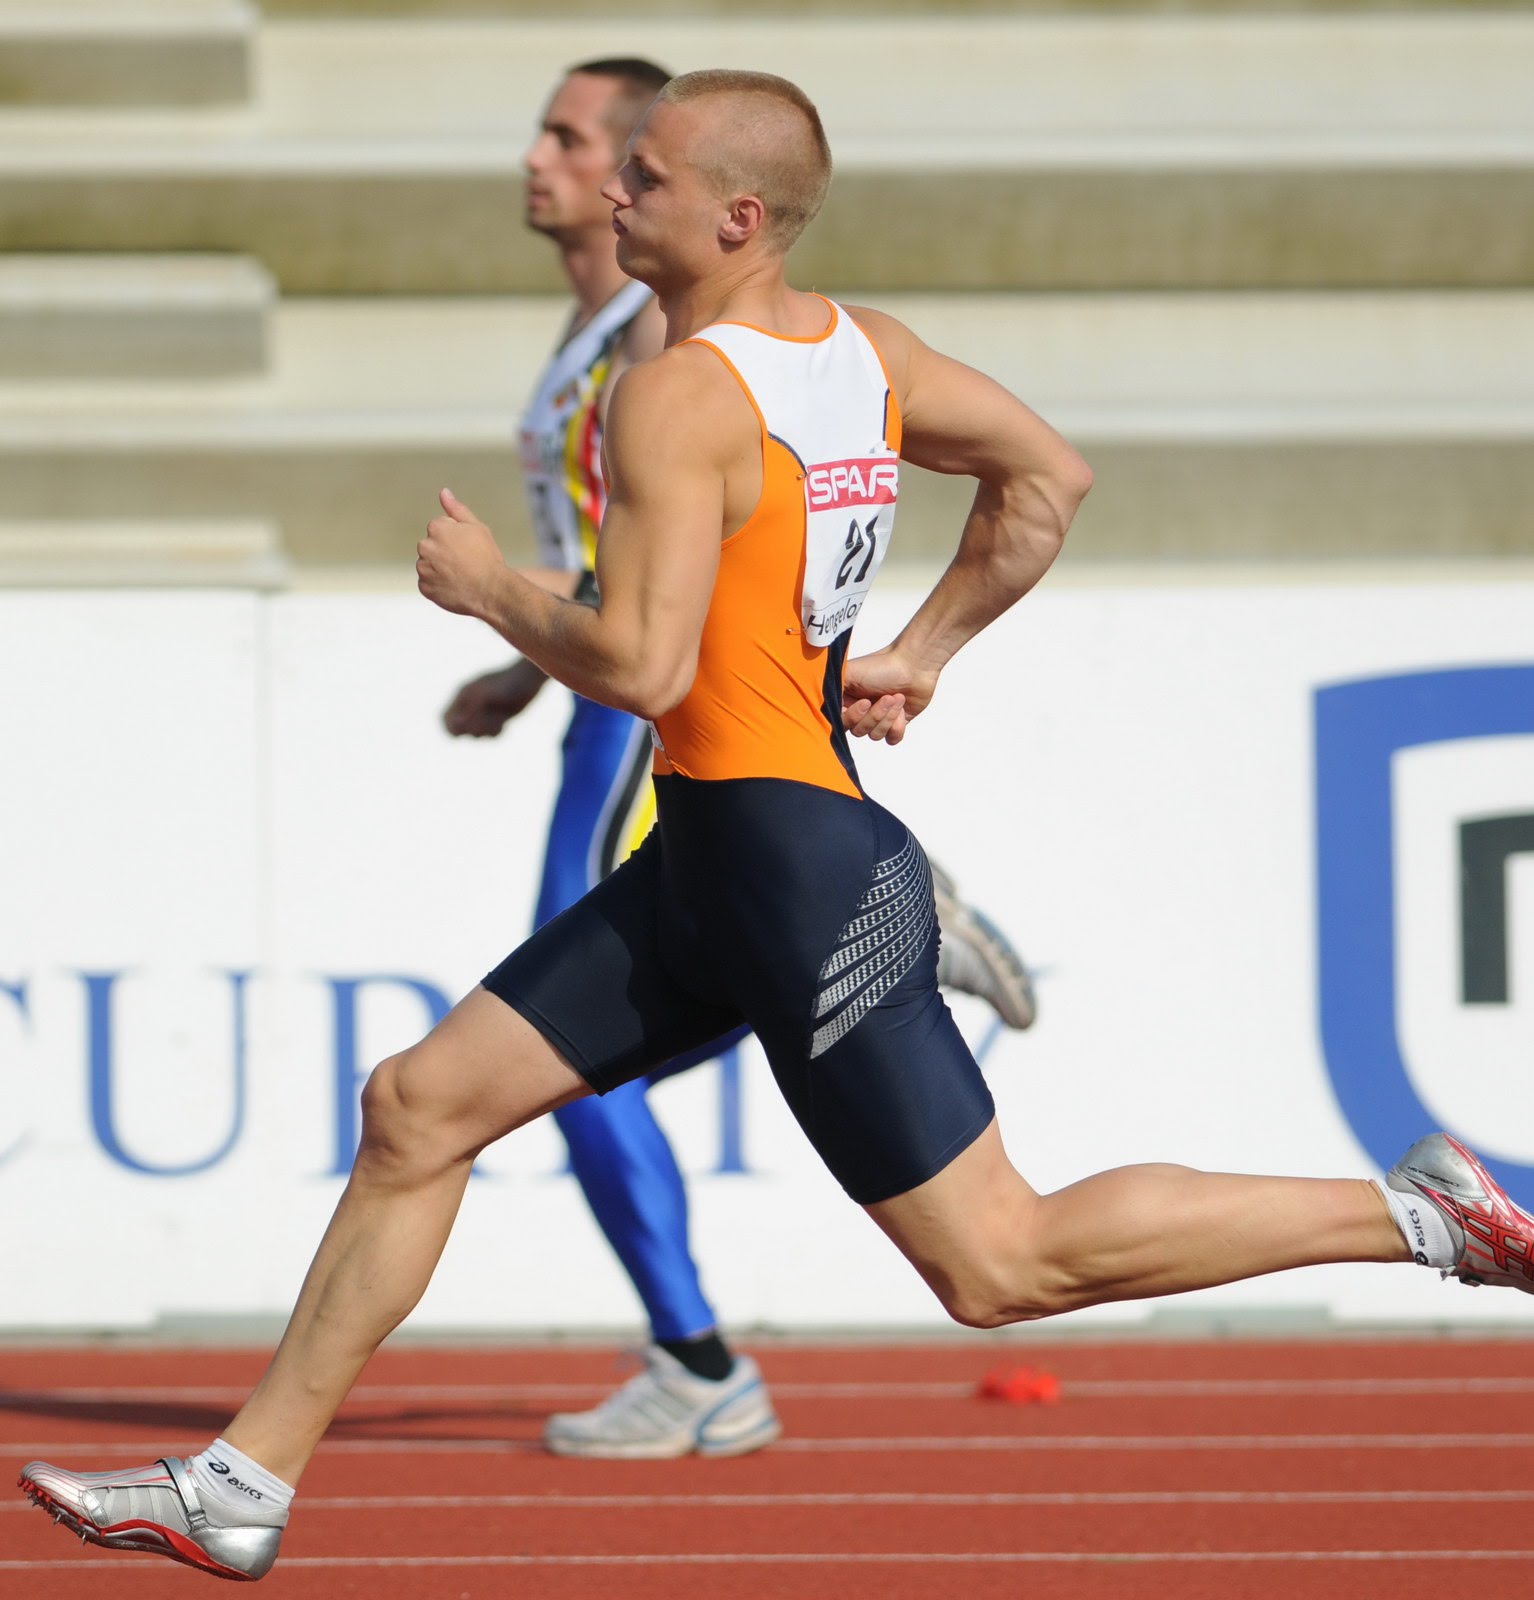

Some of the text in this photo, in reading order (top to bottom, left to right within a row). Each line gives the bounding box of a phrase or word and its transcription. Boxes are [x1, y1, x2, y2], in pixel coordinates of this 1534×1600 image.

[809, 464, 899, 505] SPAR
[835, 515, 879, 590] 21
[226, 1477, 264, 1500] asics
